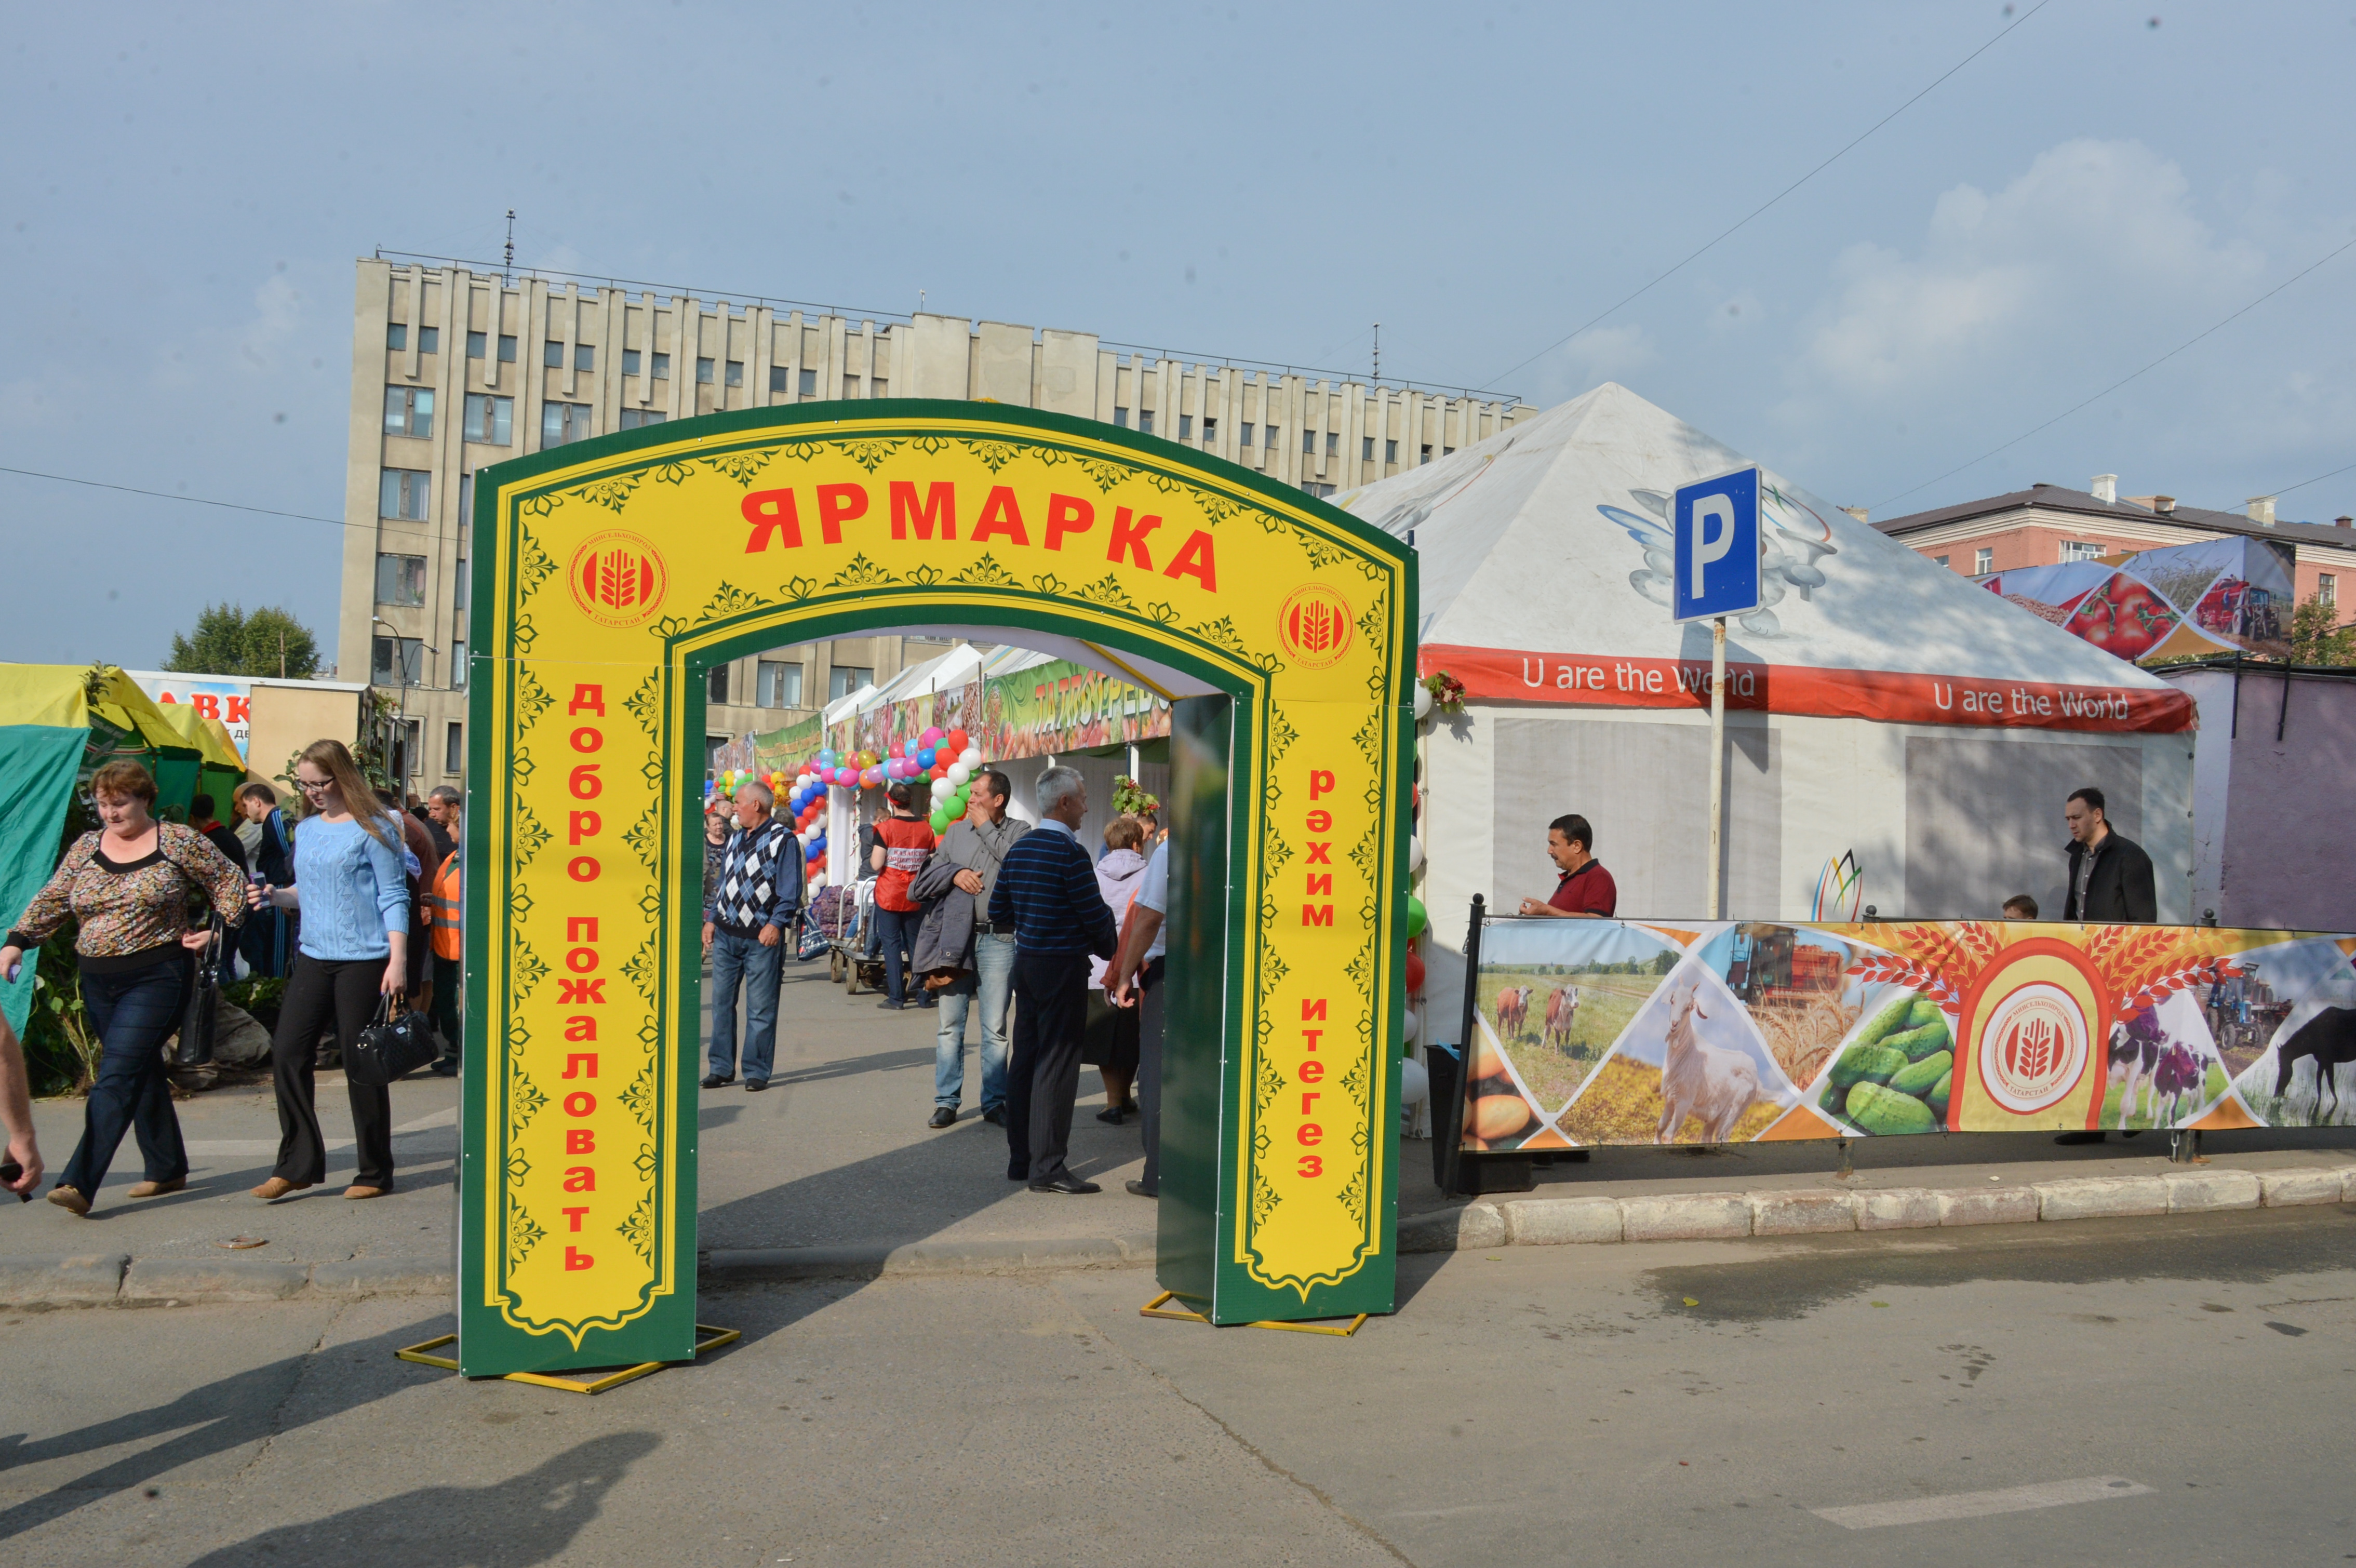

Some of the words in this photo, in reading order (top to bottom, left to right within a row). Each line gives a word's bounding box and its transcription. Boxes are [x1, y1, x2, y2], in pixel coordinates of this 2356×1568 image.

[587, 532, 652, 551] МИНСЕЛЬХОЗПРОД
[741, 480, 1217, 593] ЯРМАРКА
[1692, 493, 1735, 599] P
[1293, 585, 1342, 601] МИНСЕЛЬХОЗПРОД
[594, 613, 641, 626] ТАТАРСТАН
[1297, 657, 1333, 668] ТАТАРСТАН
[1523, 658, 1544, 688] U
[1556, 665, 1605, 690] are
[1615, 662, 1664, 693] the
[1671, 666, 1755, 696] Wold
[1934, 683, 1952, 710] U
[1963, 690, 2003, 714] are
[2012, 688, 2052, 716] the
[2058, 691, 2128, 720] World
[567, 684, 605, 882] добро
[2013, 1000, 2064, 1017] МИНСЕЛЬХОЗПРОД
[556, 917, 607, 1272] пожаловать
[1296, 999, 1327, 1179] итегез
[2010, 1086, 2049, 1096] ТАТАРСТАН
